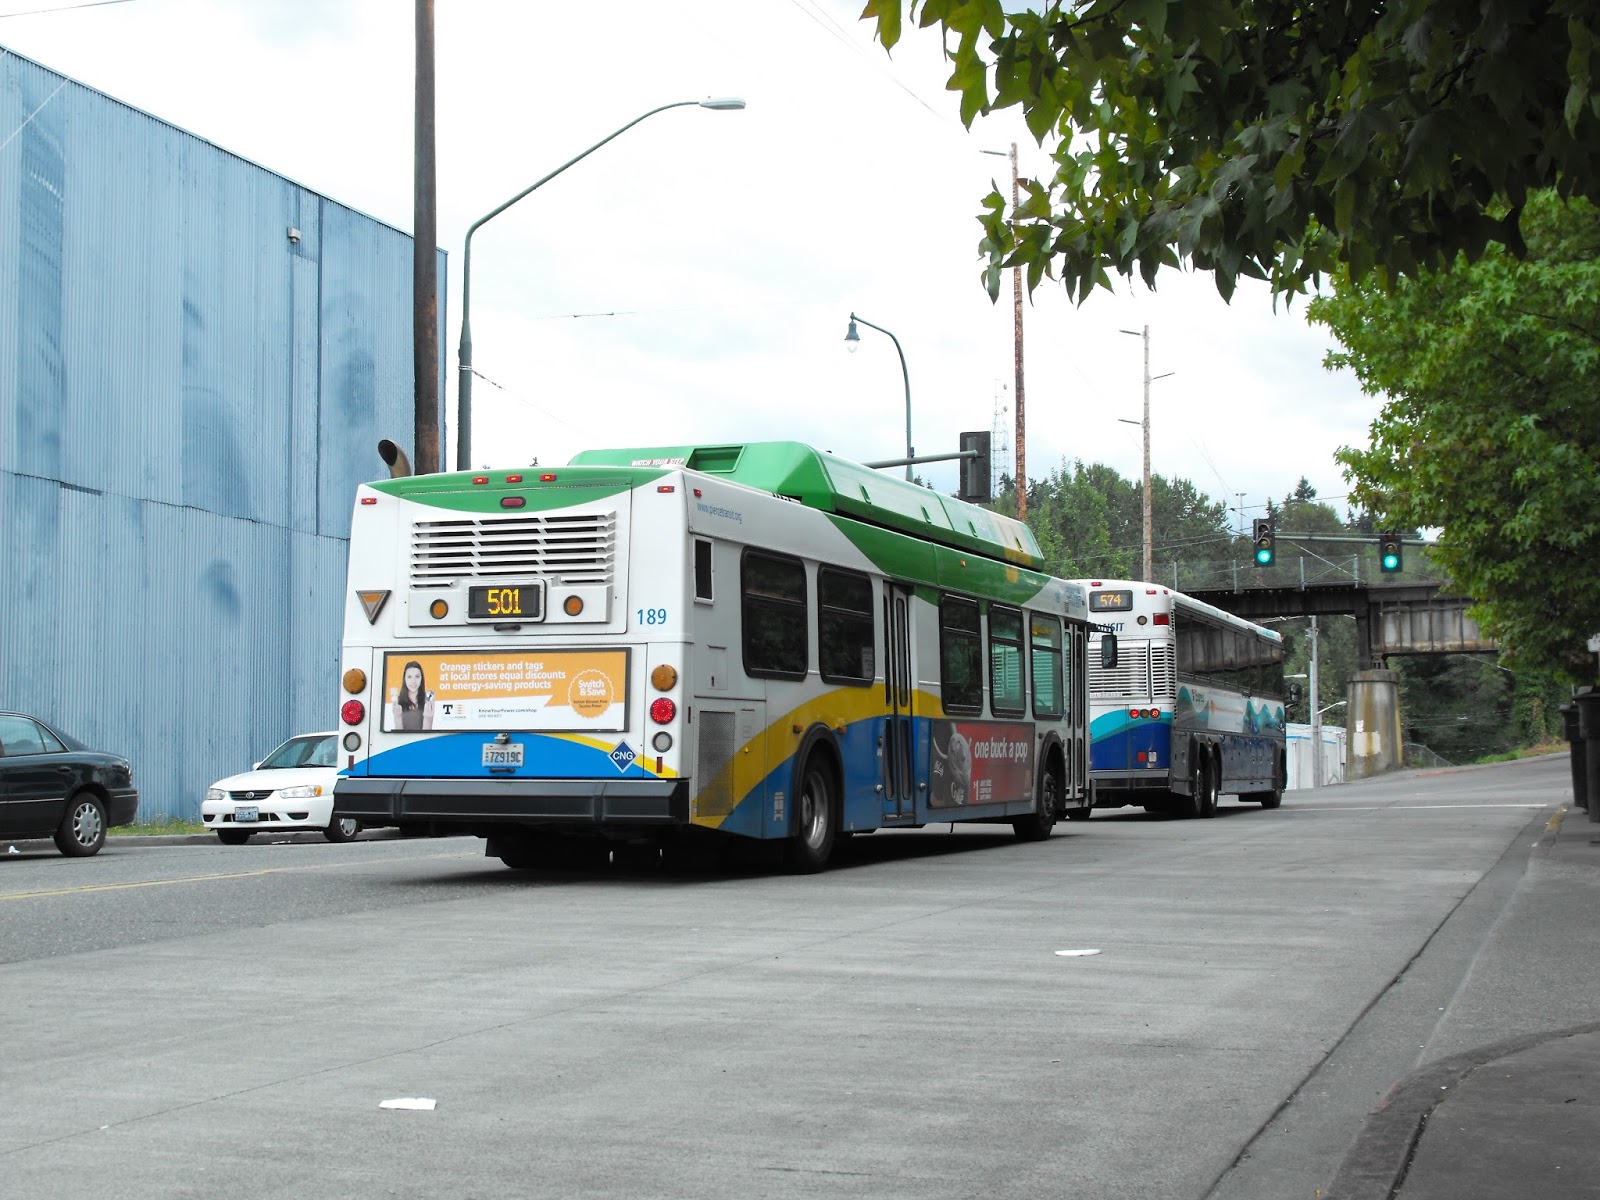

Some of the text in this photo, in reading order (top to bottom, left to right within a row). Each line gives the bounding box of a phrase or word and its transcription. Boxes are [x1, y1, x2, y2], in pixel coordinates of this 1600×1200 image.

[697, 502, 742, 525] www.piercetransit.org
[487, 588, 522, 615] 501
[1100, 594, 1122, 607] 574
[637, 608, 667, 625] 189
[440, 661, 544, 673] Orange stickers and tags
[440, 670, 566, 681] at local stores equal discounts
[439, 680, 552, 691] on energy-saving products
[578, 679, 605, 688] Switch
[580, 687, 606, 696] & Save
[442, 704, 453, 715] T
[612, 751, 633, 760] CNG
[974, 737, 1028, 763] one buck a pop
